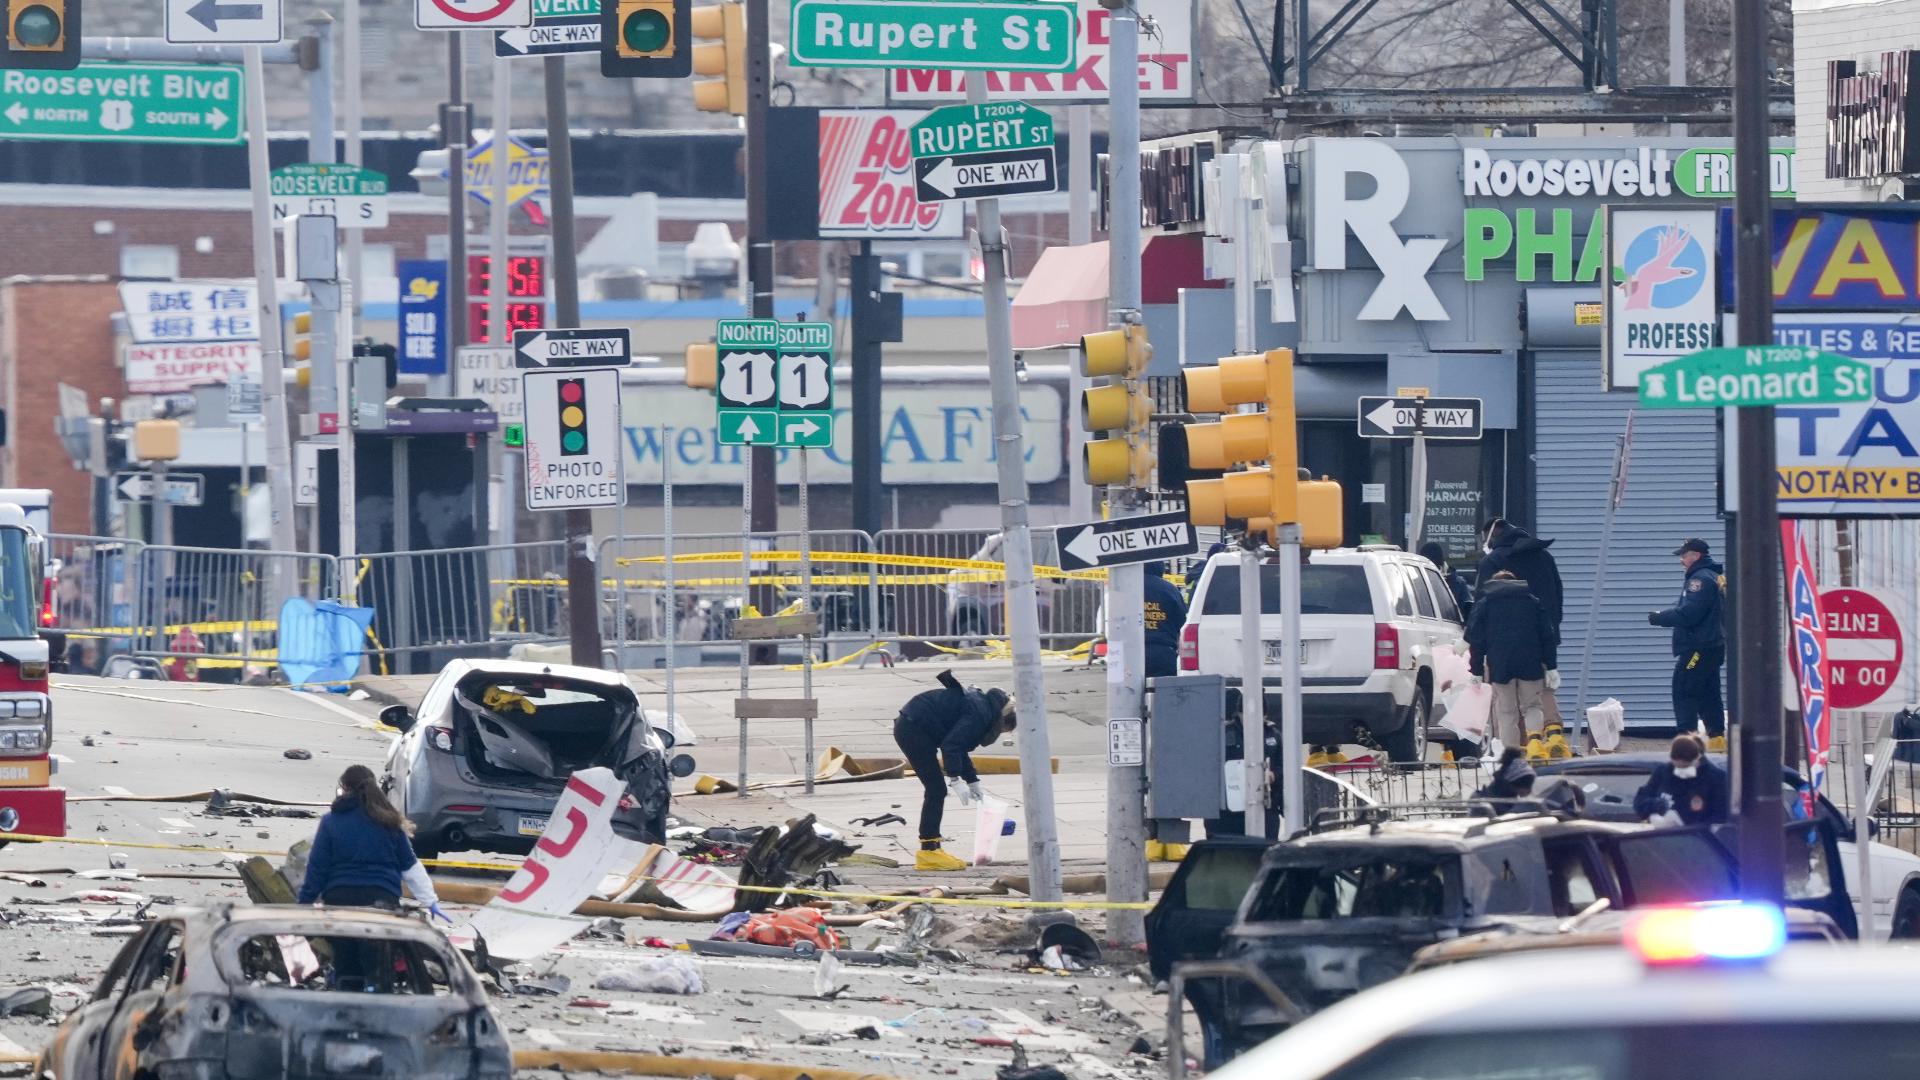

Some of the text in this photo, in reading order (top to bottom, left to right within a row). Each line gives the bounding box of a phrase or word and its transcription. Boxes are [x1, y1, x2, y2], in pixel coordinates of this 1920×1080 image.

[530, 26, 598, 43] ONE WAY
[815, 12, 978, 54] Rupert
[1002, 15, 1051, 51] St
[4, 70, 230, 100] Roosevelt Blvd
[34, 108, 89, 122] NORTH
[145, 111, 200, 125] SOUTH
[984, 106, 1015, 117] 7200
[918, 119, 1049, 153] RUPERT ST
[957, 162, 1039, 185] ONE WAY
[1464, 147, 1671, 196] Roosevelt
[360, 203, 372, 219] S
[1315, 137, 1450, 320] Rx
[722, 324, 775, 341] NORTH
[779, 327, 827, 344] SOUTH
[1861, 329, 1878, 351] &
[549, 340, 618, 356] ONE WAY
[472, 378, 519, 394] MUST
[739, 360, 752, 395] 1
[792, 362, 807, 398] 1
[1677, 364, 1868, 402] Leonard St
[1434, 410, 1468, 425] WAY
[547, 461, 603, 478] PHOTO
[534, 482, 617, 500] ENFORCED
[1777, 470, 1887, 494] NOTARY
[1099, 526, 1180, 552] ONE WAY
